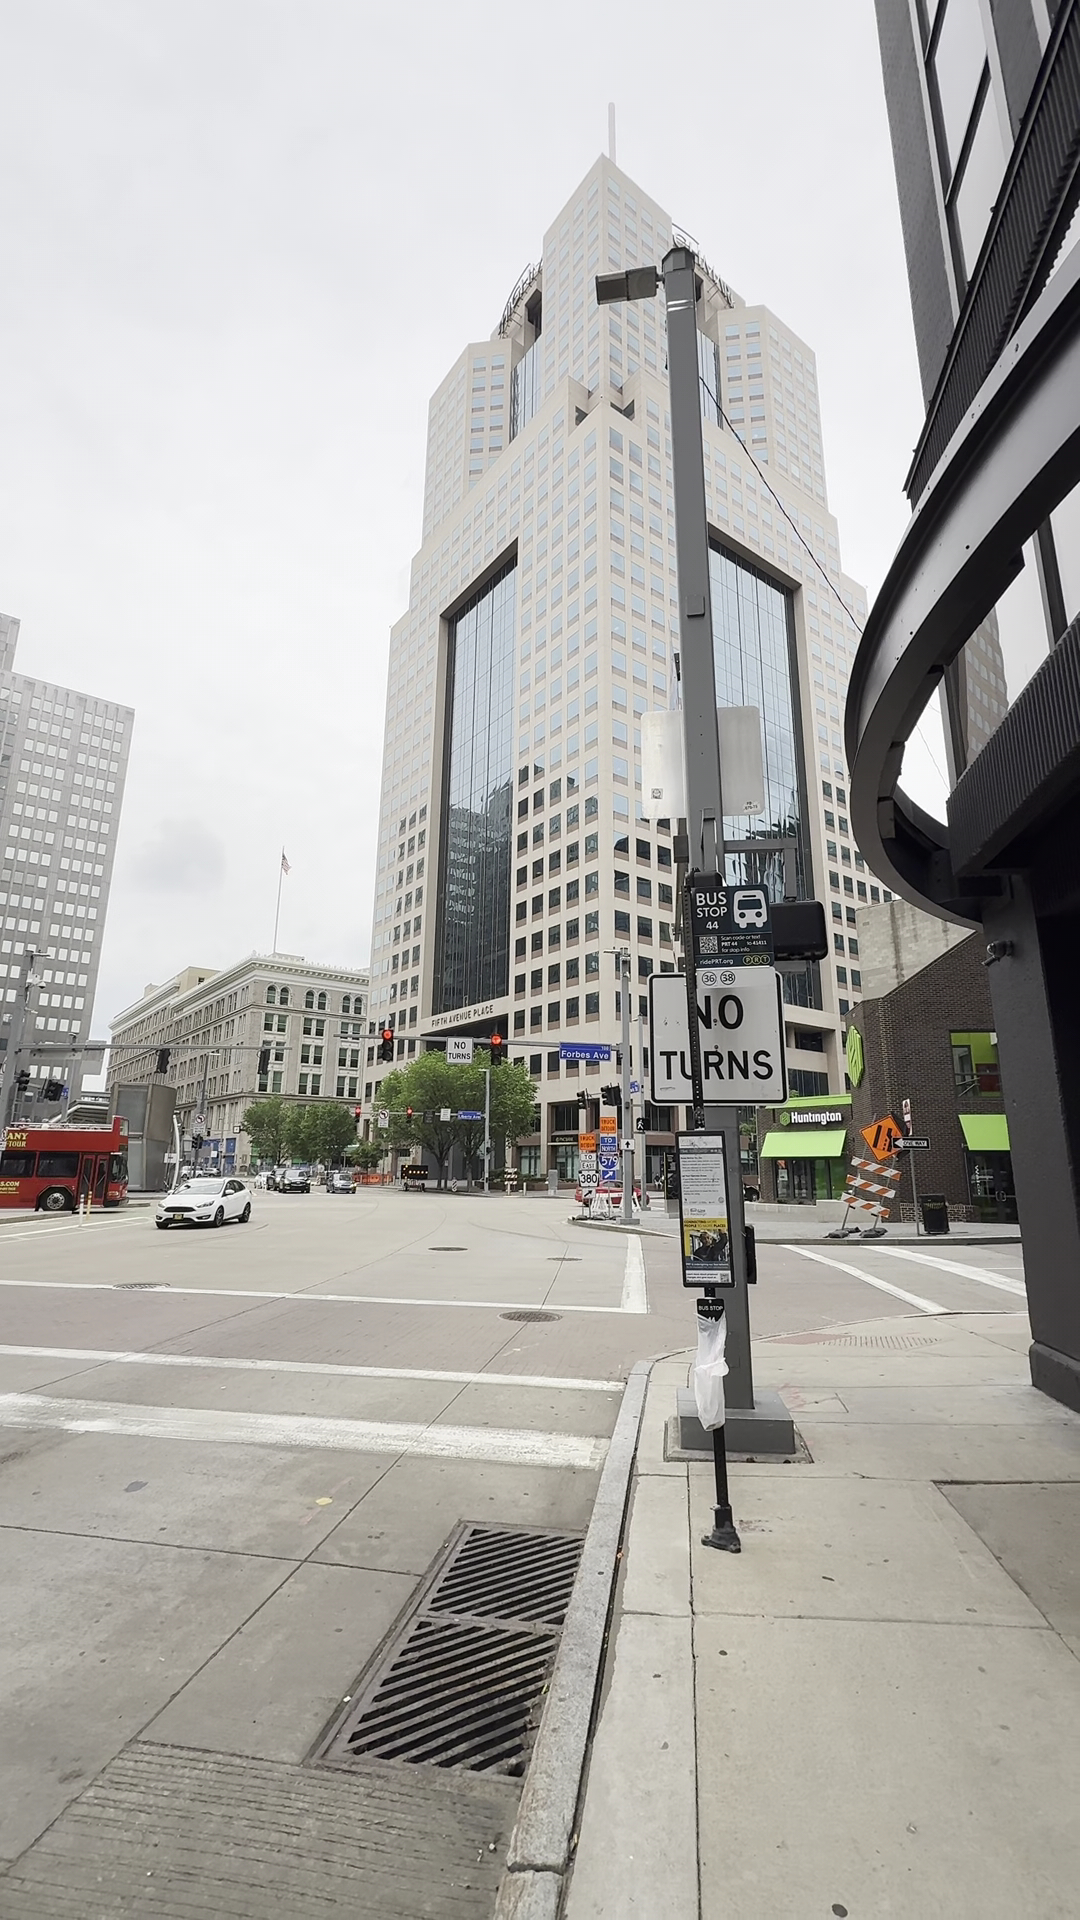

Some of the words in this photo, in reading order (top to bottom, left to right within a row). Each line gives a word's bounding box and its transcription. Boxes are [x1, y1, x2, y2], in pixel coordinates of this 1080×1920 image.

[696, 891, 727, 906] BUS
[696, 906, 728, 918] STOP
[706, 921, 719, 930] 44
[703, 974, 716, 984] 36
[722, 973, 734, 983] 38
[431, 1018, 448, 1028] FIFTH
[448, 1012, 472, 1023] AVENUE
[473, 1004, 494, 1018] PLACE
[696, 994, 744, 1030] NO
[453, 1041, 467, 1049] NO
[561, 1051, 591, 1059] Forbes
[593, 1052, 609, 1060] Ave
[659, 1050, 773, 1080] TURNS
[791, 1111, 842, 1125] Huntington
[7, 1132, 29, 1140] ANY
[601, 1156, 619, 1166] 579
[580, 1174, 598, 1184] 380
